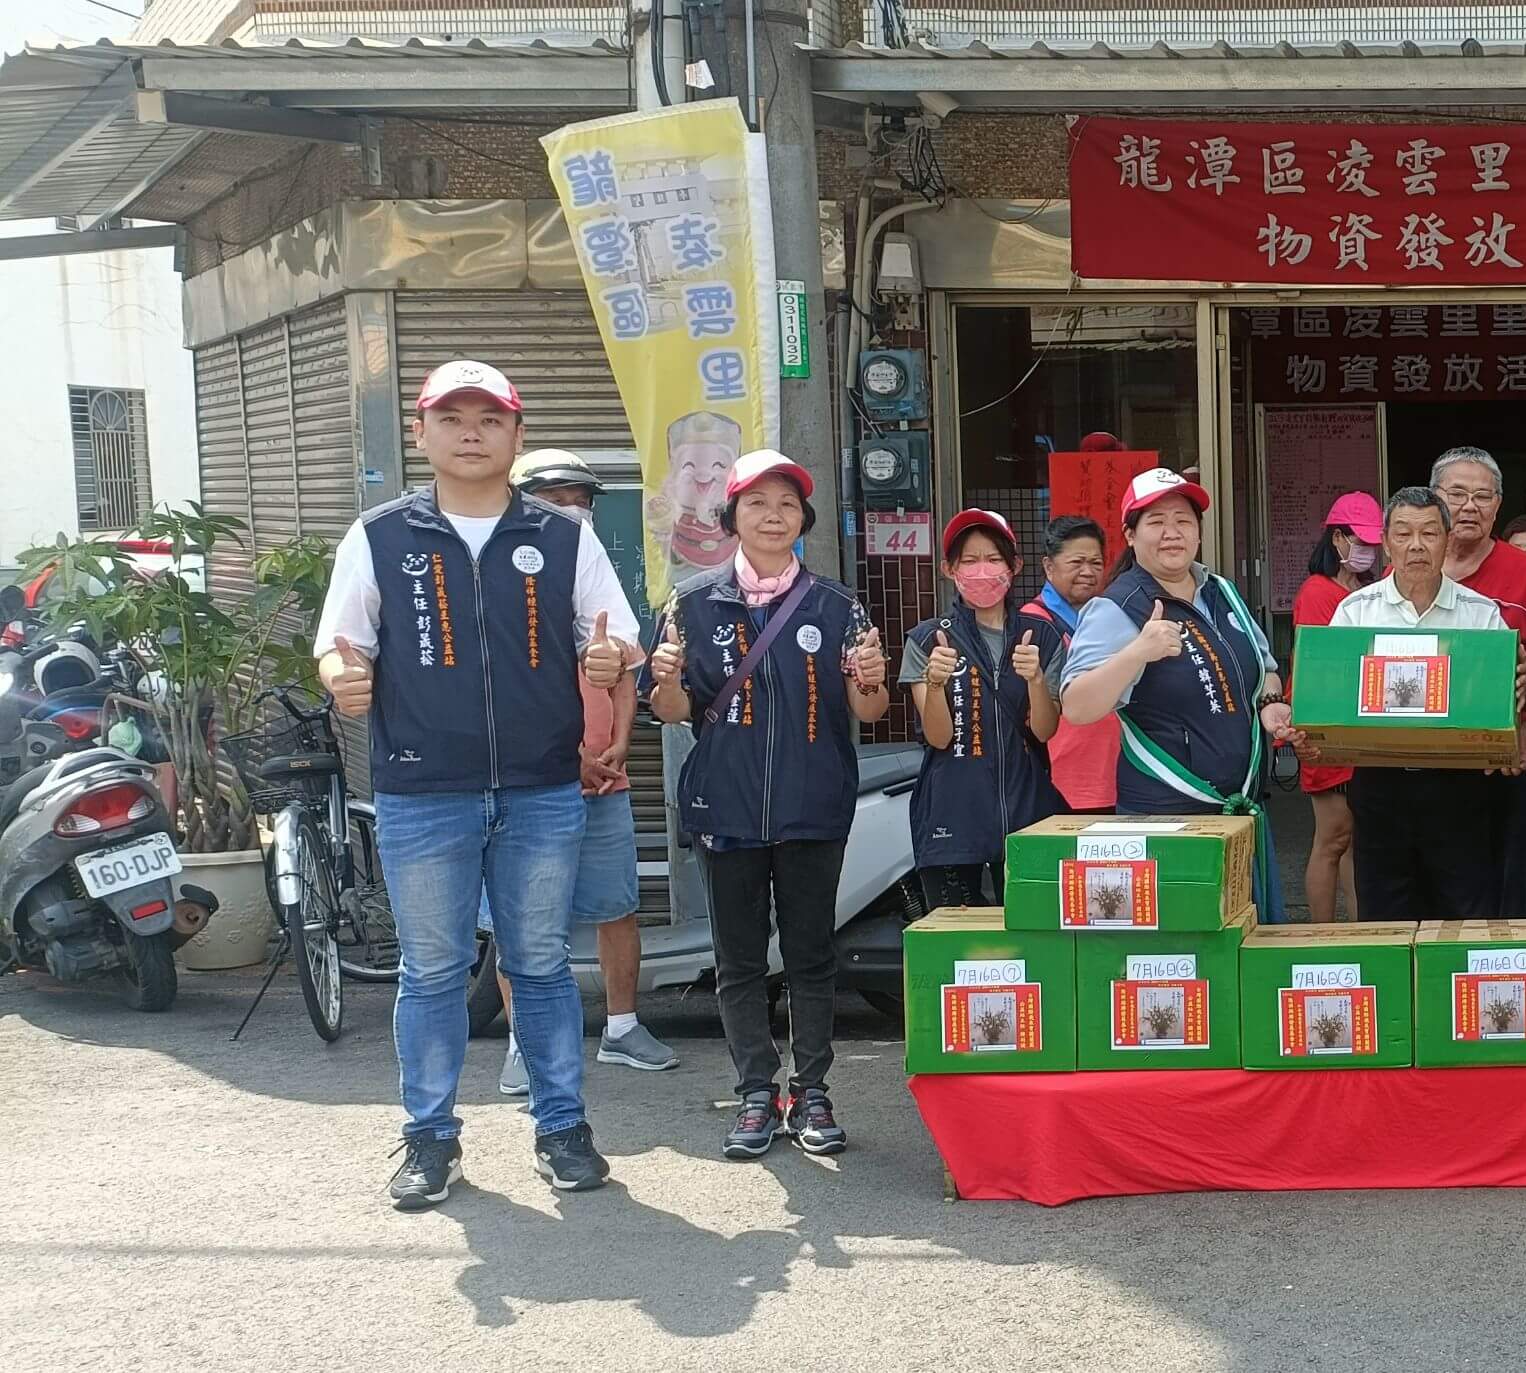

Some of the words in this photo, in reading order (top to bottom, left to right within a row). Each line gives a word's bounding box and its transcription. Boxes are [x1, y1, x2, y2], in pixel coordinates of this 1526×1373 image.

[784, 296, 799, 364] 0311032
[885, 530, 917, 551] 44
[413, 580, 428, 610] 主任
[1185, 641, 1205, 664] 主任
[953, 680, 964, 706] 主任
[88, 847, 172, 889] 160-DJP
